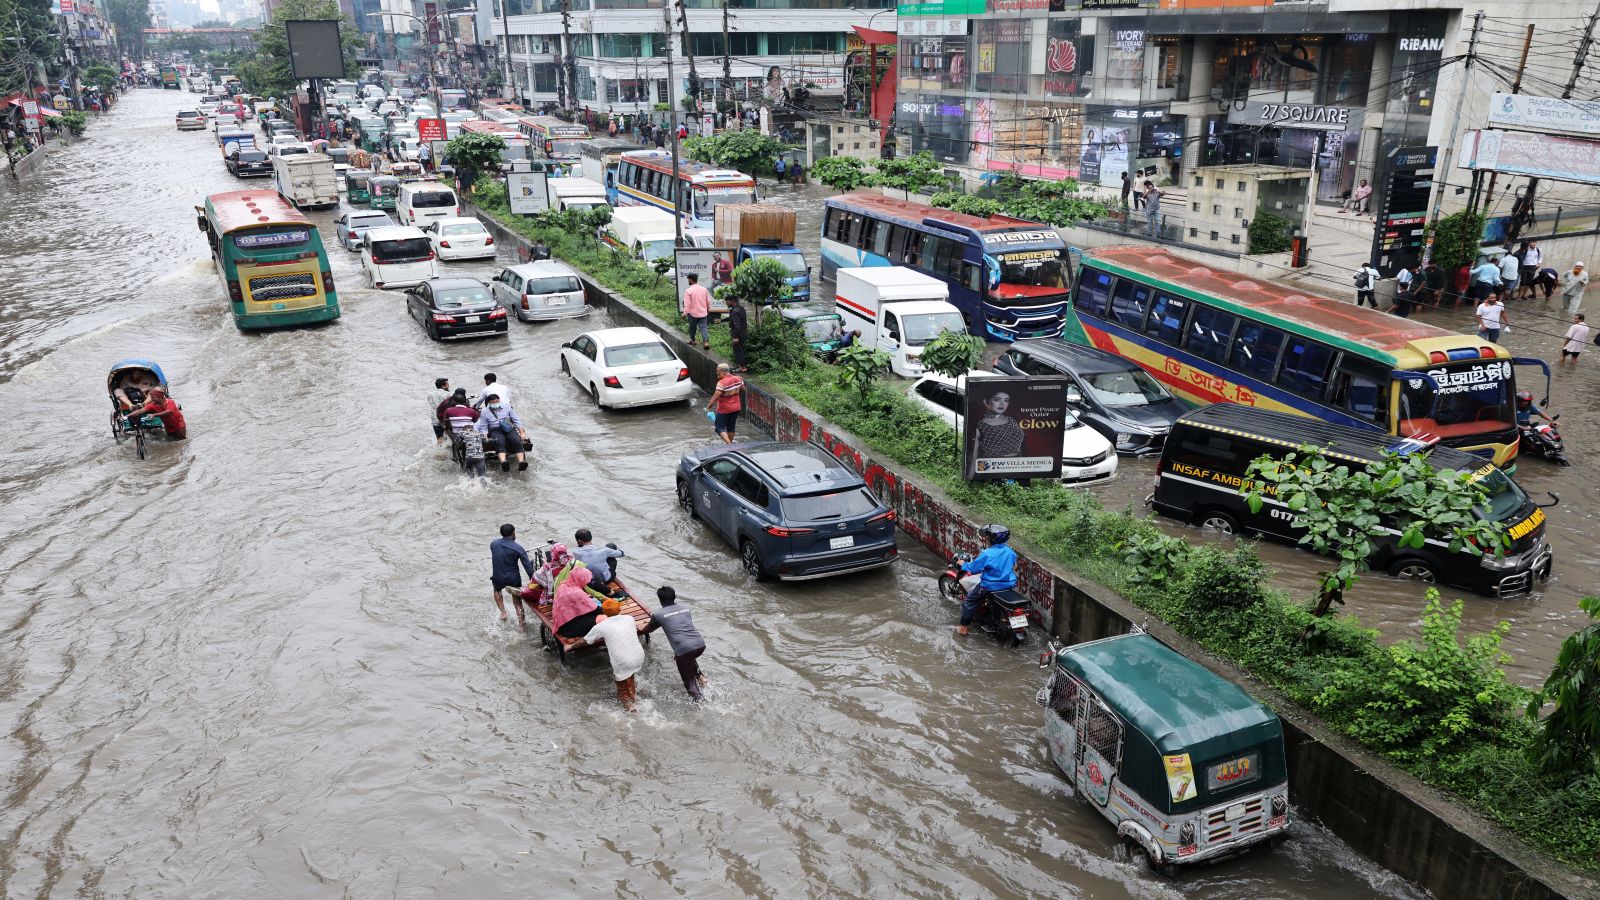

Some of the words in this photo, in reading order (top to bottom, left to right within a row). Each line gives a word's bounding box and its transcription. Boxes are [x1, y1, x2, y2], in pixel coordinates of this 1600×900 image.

[1117, 30, 1145, 41] IVORY
[1345, 33, 1369, 41] IVORY
[902, 103, 931, 114] SONY
[1528, 98, 1569, 110] PANCARE
[1113, 109, 1138, 119] ASUS
[1142, 110, 1164, 118] ASUS
[1261, 104, 1277, 119] 27
[1280, 104, 1350, 124] SQUARE
[1492, 112, 1521, 121] PANCARE
[1535, 109, 1575, 119] FERTILITY
[1396, 155, 1408, 166] 27
[1019, 418, 1060, 429] Glow
[1172, 462, 1210, 479] INSAF
